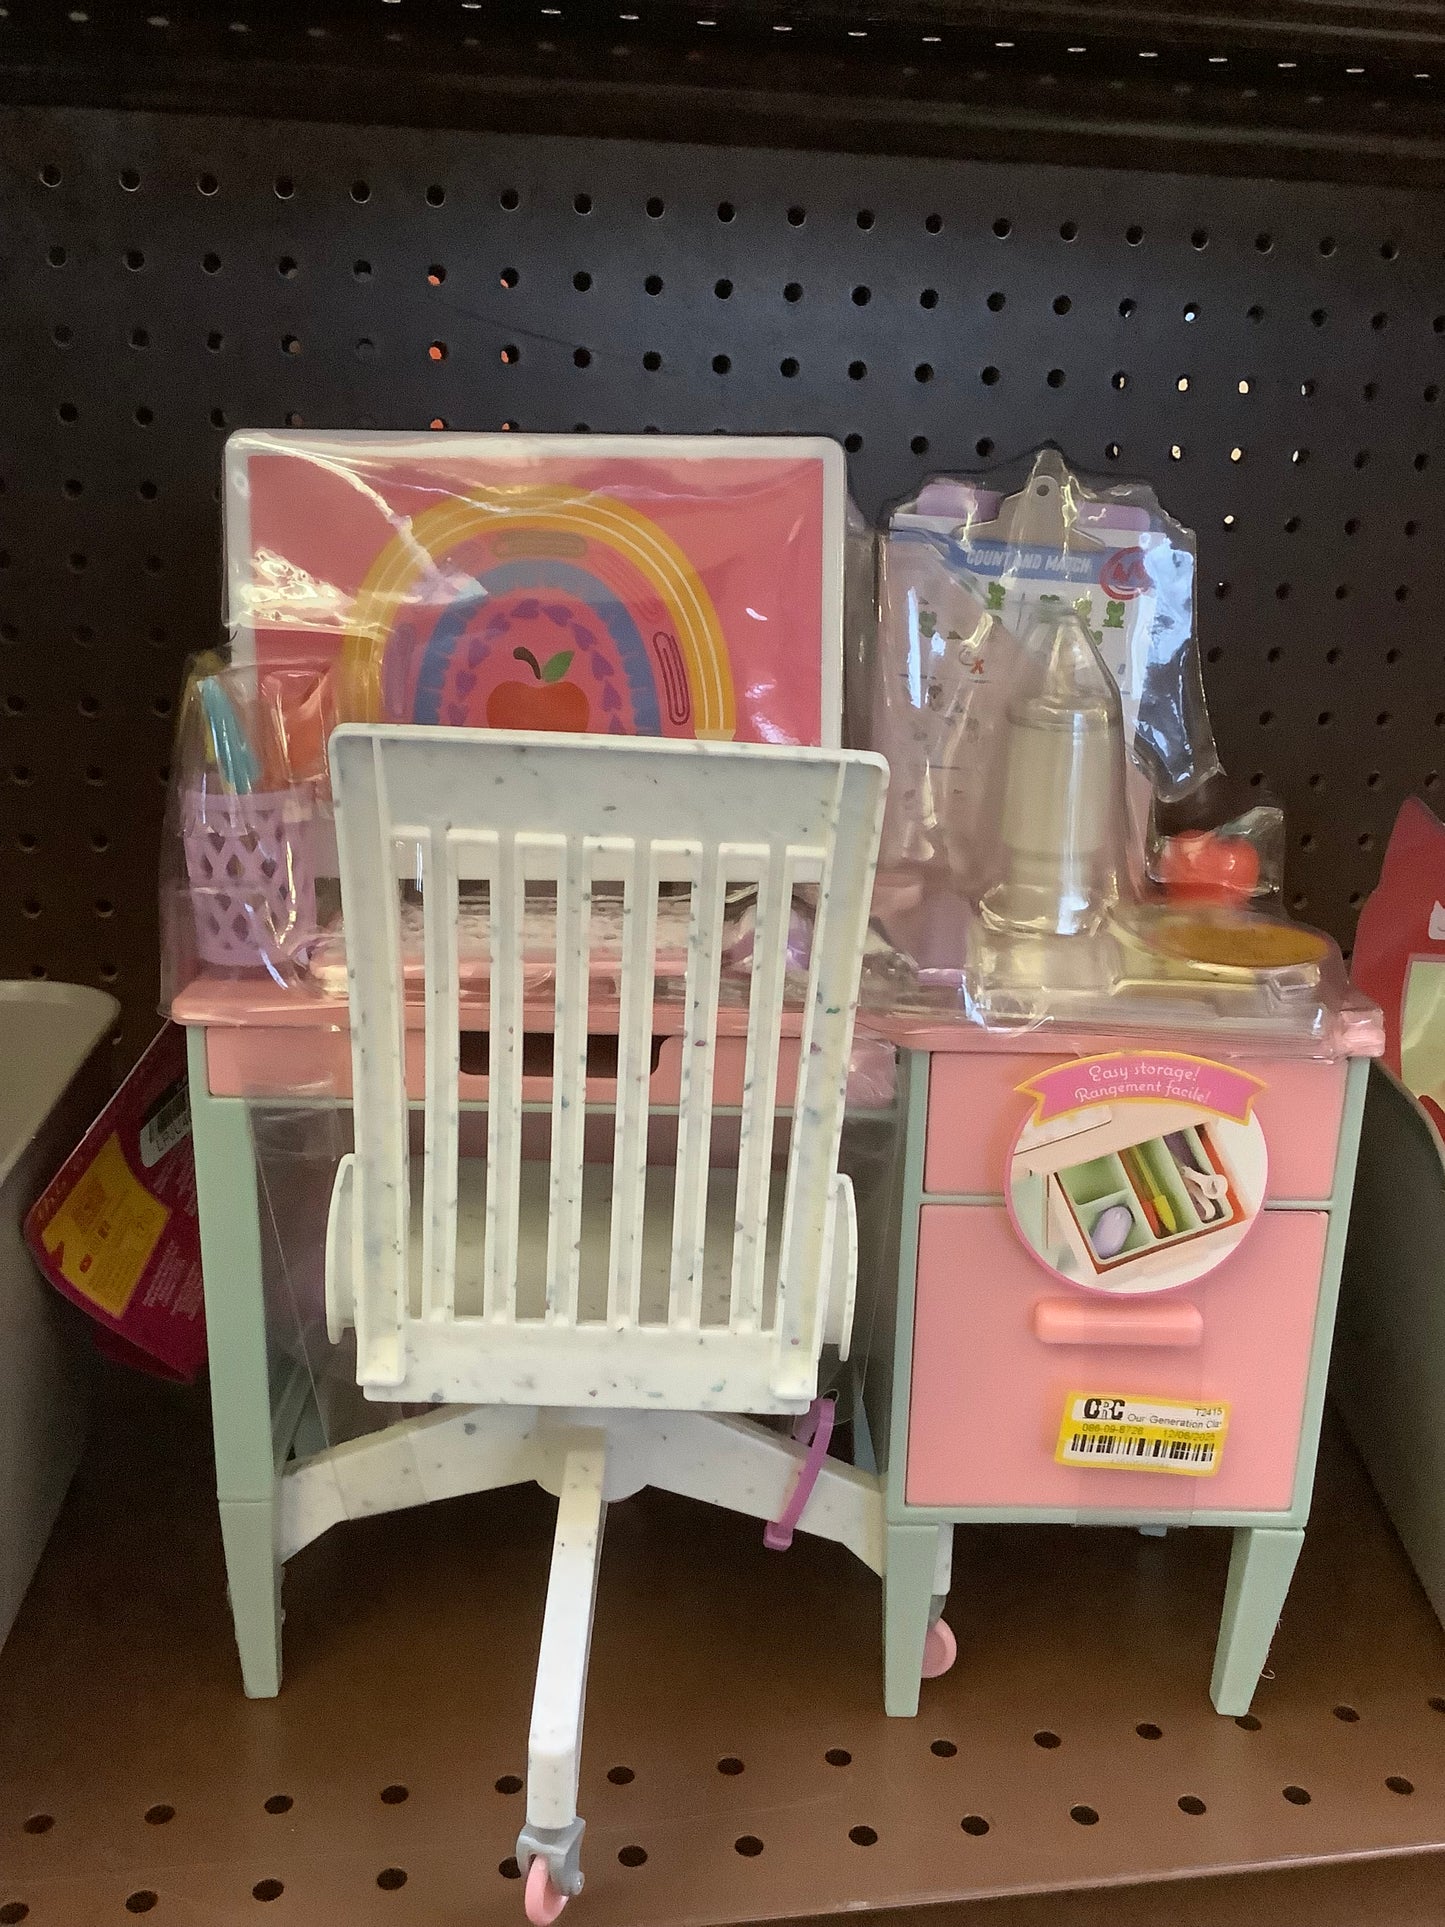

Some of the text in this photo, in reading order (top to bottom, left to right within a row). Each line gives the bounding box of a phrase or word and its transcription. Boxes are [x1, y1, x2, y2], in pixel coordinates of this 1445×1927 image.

[966, 549, 1092, 573] COUNT AND MATCH
[1088, 1062, 1200, 1082] Easy storage!
[1074, 1080, 1212, 1103] Rangement facile!
[1127, 1413, 1145, 1423] Our
[1149, 1415, 1204, 1429] Generation
